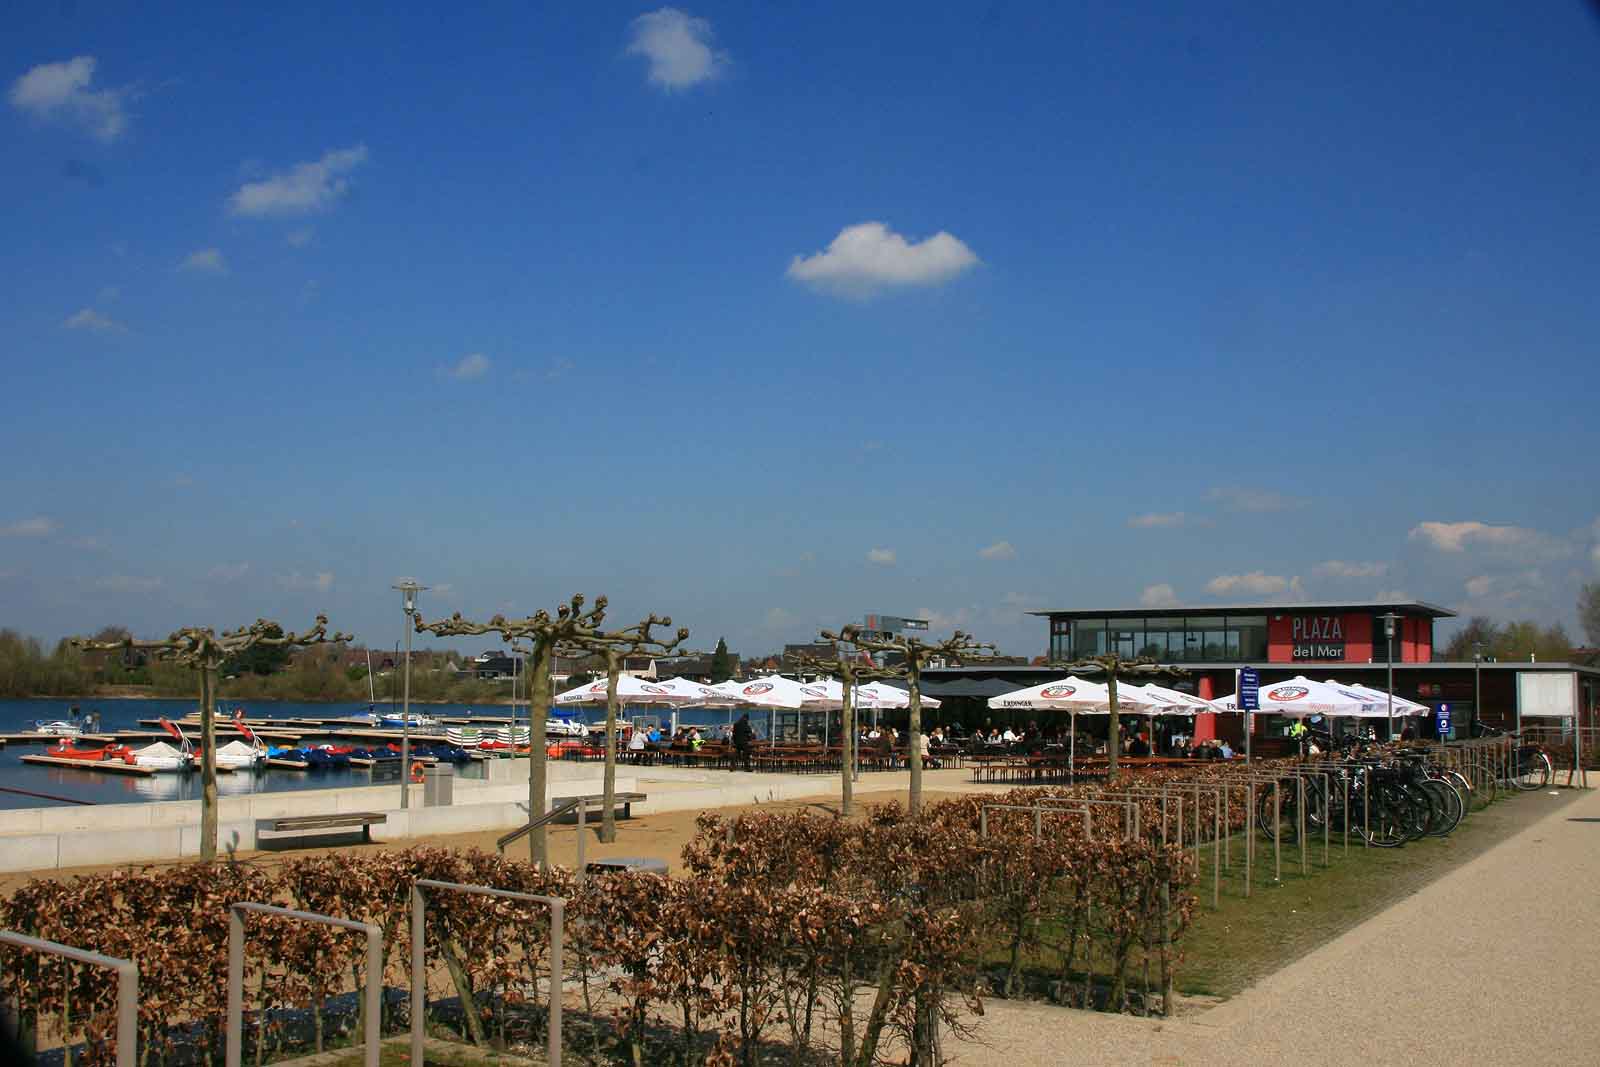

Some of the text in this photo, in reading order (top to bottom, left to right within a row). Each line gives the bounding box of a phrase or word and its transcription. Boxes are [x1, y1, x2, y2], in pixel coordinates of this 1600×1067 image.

[1293, 617, 1342, 639] PLAZA
[1293, 644, 1342, 657] del Mar
